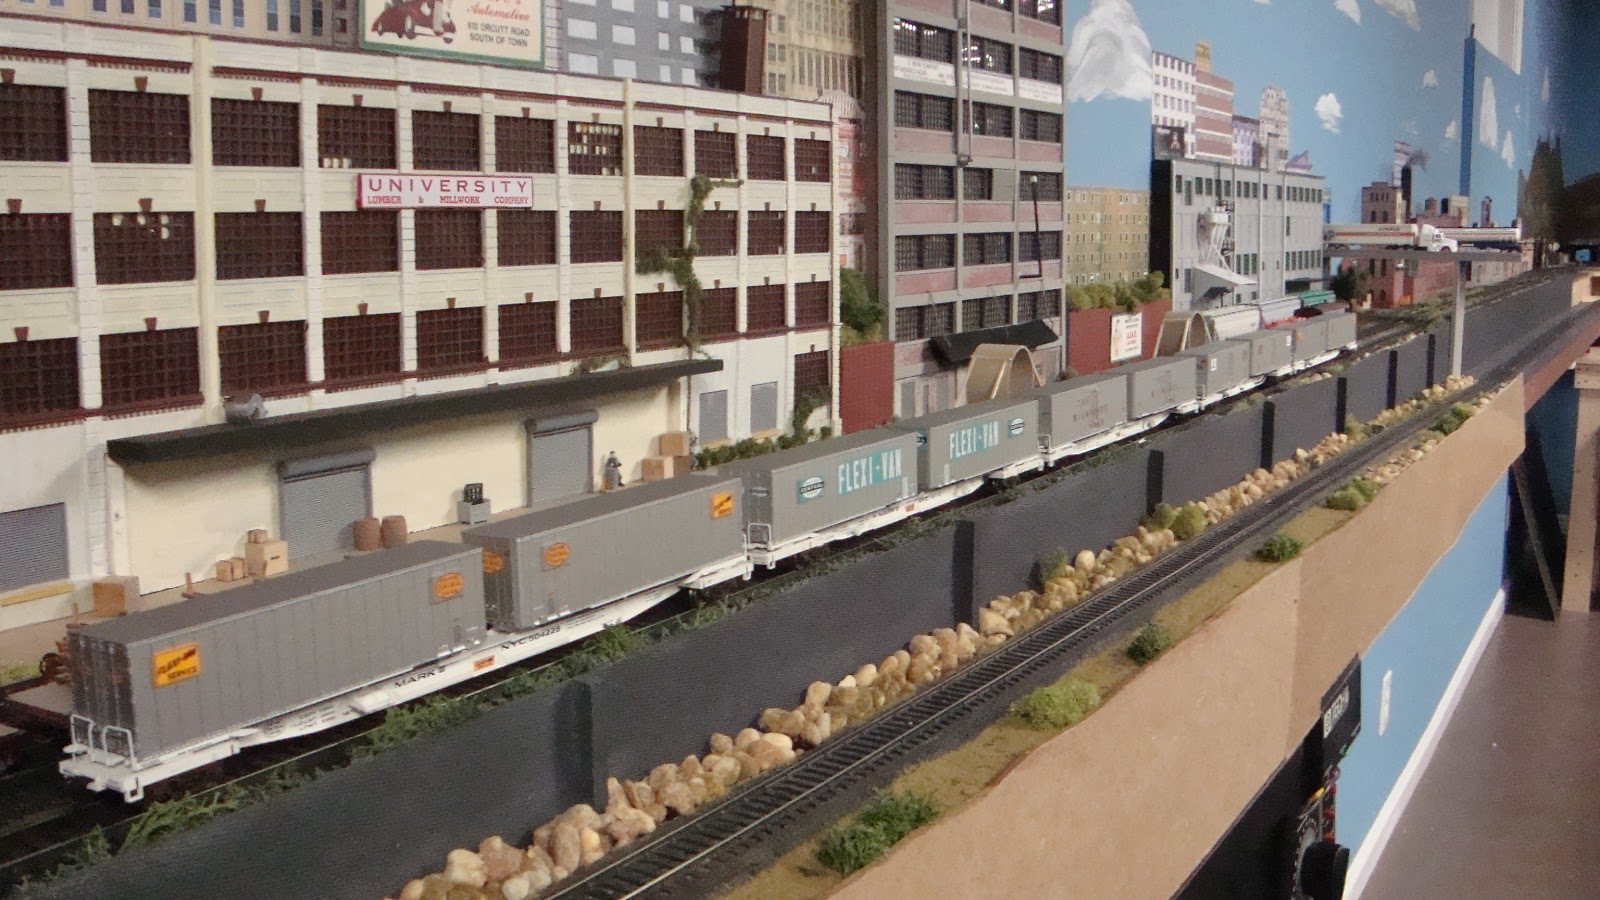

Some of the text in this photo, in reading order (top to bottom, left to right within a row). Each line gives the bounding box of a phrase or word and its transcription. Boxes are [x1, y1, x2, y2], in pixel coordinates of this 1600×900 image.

[511, 27, 530, 37] ROAD
[470, 32, 528, 47] SOUTH OF TOWN
[369, 178, 527, 193] UNIVERSITY
[367, 195, 528, 205] LUMBER & MILLWORK COMPANY
[501, 637, 527, 650] NYC
[394, 670, 435, 688] MARK
